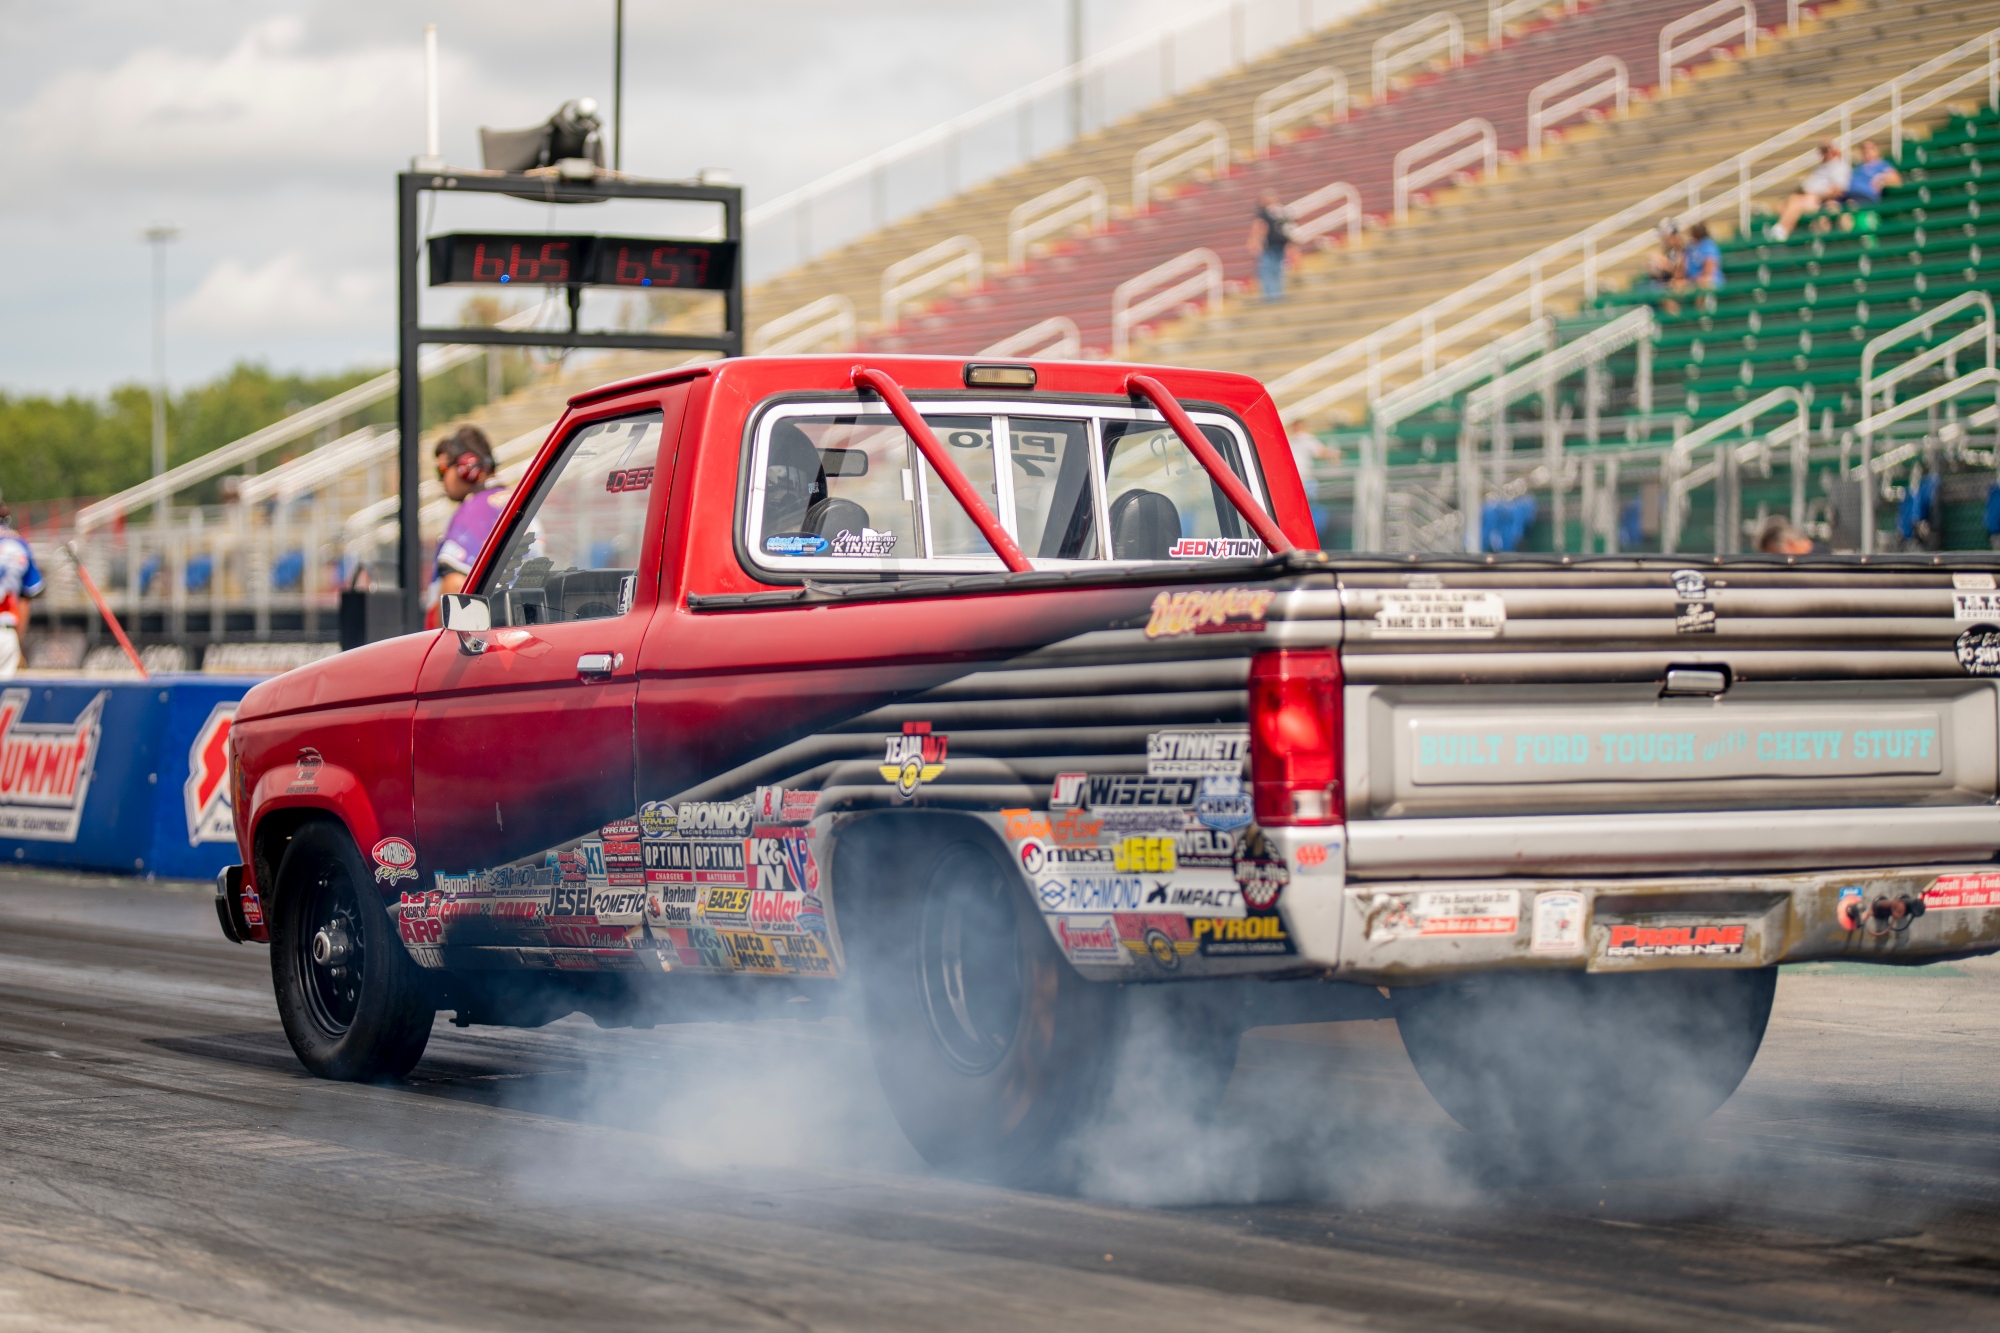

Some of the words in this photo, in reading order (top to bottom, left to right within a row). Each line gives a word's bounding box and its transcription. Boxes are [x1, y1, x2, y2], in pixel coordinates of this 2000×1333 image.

[831, 529, 861, 546] Jim
[833, 541, 894, 554] KINNEY
[1170, 539, 1260, 557] JEDNATION
[1387, 616, 1413, 628] NAME
[1158, 733, 1250, 760] STINNETT
[1419, 734, 1503, 765] BUILT
[1514, 734, 1589, 765] FORD
[1600, 733, 1696, 764] TOUGH
[1702, 727, 1748, 763] with
[1756, 731, 1843, 761] CHEVY
[1853, 729, 1936, 759] STUFF
[1152, 762, 1239, 772] RACING
[641, 817, 678, 826] TAYLOR
[678, 801, 752, 830] BIONDO
[1178, 831, 1235, 856] WELD
[645, 845, 691, 867] OPTIMA
[695, 845, 743, 868] OPTIMA
[1114, 836, 1177, 872] JEGS
[1179, 857, 1232, 867] RACING
[655, 872, 684, 880] CHARGERS
[706, 873, 736, 881] BATTERIES
[1961, 878, 1979, 890] Jane
[543, 887, 597, 916] JESEL
[662, 885, 697, 903] Harland
[707, 890, 750, 910] EARL'S
[1067, 878, 1143, 909] RICHMOND
[1170, 888, 1240, 908] IMPACT
[1923, 893, 1960, 906] American
[1961, 892, 1988, 904] Traitor
[592, 892, 647, 915] COMETIC
[752, 891, 801, 923] Holley
[665, 904, 692, 922] Sharp
[399, 919, 443, 943] ARP
[761, 923, 770, 931] HP
[772, 923, 795, 931] CARBS
[1193, 916, 1287, 940] PYROIL
[590, 932, 626, 948] Edelbrock
[733, 933, 765, 951] Auto
[786, 934, 818, 954] Auto
[1607, 944, 1742, 956] RACING.NET
[736, 951, 776, 969] Meter
